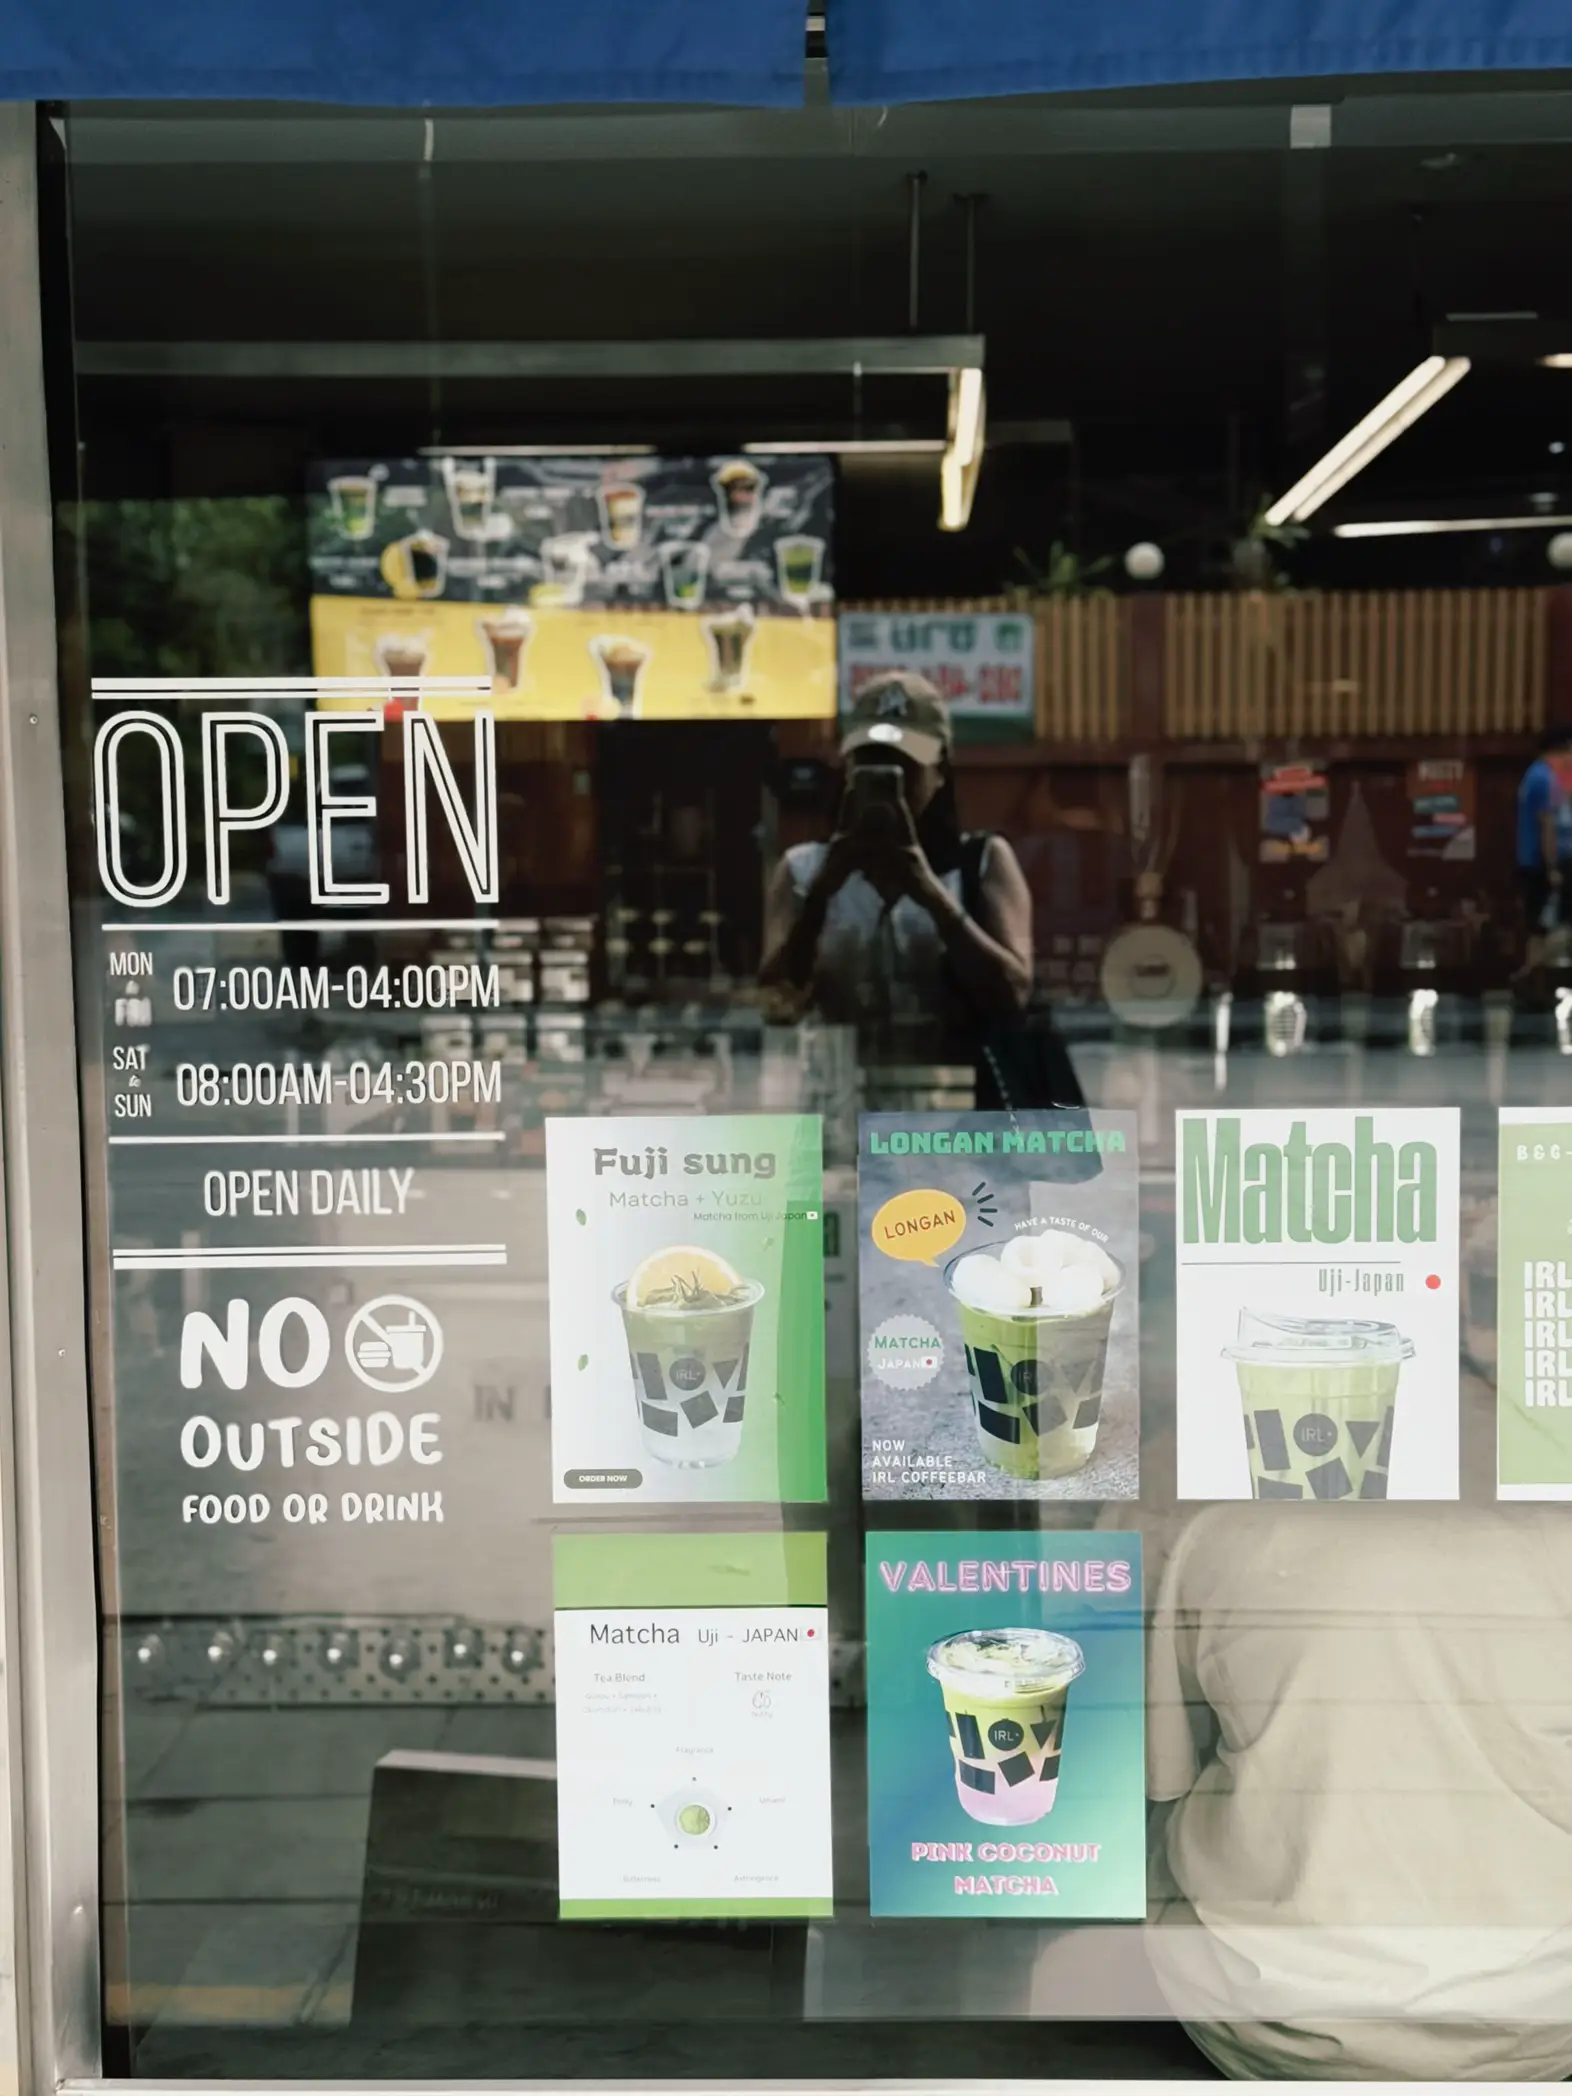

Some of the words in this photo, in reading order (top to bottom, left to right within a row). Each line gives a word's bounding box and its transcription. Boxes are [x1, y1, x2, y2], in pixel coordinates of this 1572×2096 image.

[94, 710, 499, 907] OPEN
[110, 952, 153, 976] MON
[173, 965, 500, 1010] 07:00AM-04:00PM
[113, 1045, 149, 1070] SAT
[177, 1061, 501, 1106] 08:00AM-04:30PM
[115, 1094, 152, 1117] SUN
[870, 1131, 994, 1155] LONGAN
[1002, 1130, 1126, 1154] MATCHA
[593, 1147, 668, 1180] Fuji
[683, 1152, 777, 1180] sung
[204, 1169, 299, 1217] OPEN
[311, 1167, 414, 1216] DAILY
[1182, 1116, 1438, 1244] Matcha
[609, 1190, 689, 1208] Matcha
[712, 1189, 762, 1206] Yuzu
[694, 1211, 732, 1221] Matcha
[734, 1211, 759, 1221] from
[775, 1210, 807, 1222] Japan
[884, 1210, 957, 1240] LONGAN
[1014, 1217, 1038, 1231] HAVE
[1040, 1216, 1047, 1225] A
[1049, 1216, 1076, 1229] TASTE
[1078, 1222, 1091, 1231] OF
[1091, 1228, 1109, 1243] OUR
[180, 1297, 331, 1390] NO
[874, 1335, 941, 1349] MATCHA
[878, 1357, 920, 1370] JAPAN
[180, 1411, 443, 1471] OUTSIDE
[872, 1439, 905, 1451] NOW
[872, 1455, 953, 1467] AVAILABLE
[579, 1475, 605, 1483] ORDER
[872, 1471, 895, 1483] IRL
[901, 1471, 986, 1484] COFFEEBAR
[183, 1494, 270, 1524] FOOD
[283, 1494, 328, 1524] OR
[341, 1491, 445, 1523] DRINK
[879, 1560, 1132, 1593] VALENTINES
[590, 1623, 681, 1645] Matcha
[698, 1628, 719, 1647] Uji
[742, 1627, 799, 1644] JAPAN
[594, 1673, 612, 1683] Tea
[615, 1672, 646, 1683] Blend
[734, 1671, 764, 1682] Taste
[766, 1671, 792, 1681] Note
[994, 1730, 1014, 1742] IRL
[911, 1842, 974, 1863] PINK
[977, 1842, 1101, 1863] COCONUT
[954, 1875, 1060, 1896] MATCHA
